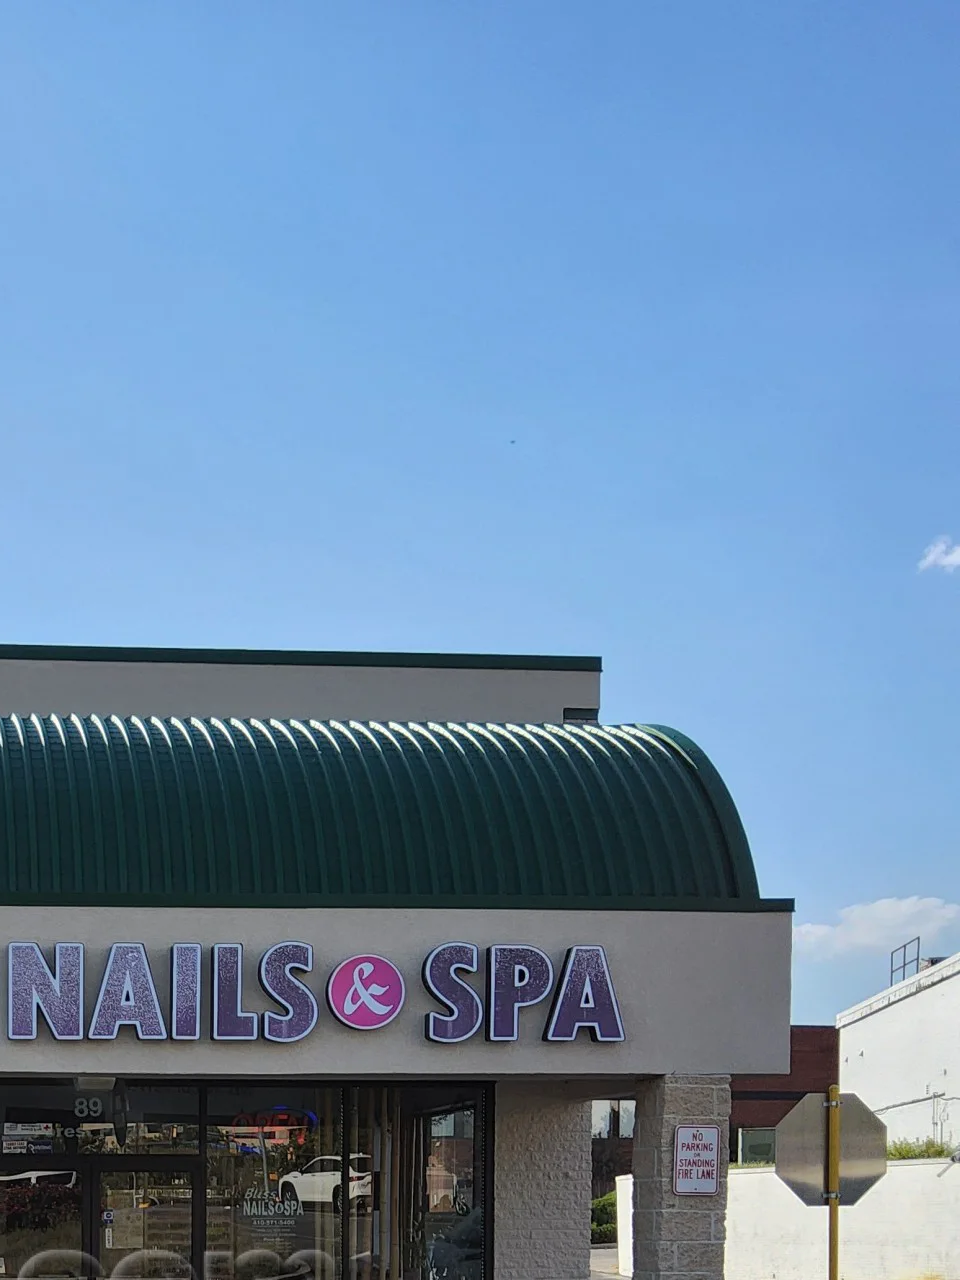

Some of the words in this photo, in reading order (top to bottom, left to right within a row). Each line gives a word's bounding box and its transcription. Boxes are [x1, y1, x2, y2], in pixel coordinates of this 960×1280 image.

[7, 940, 315, 1044] NAILS
[339, 963, 396, 1017] &
[424, 941, 626, 1045] SPA
[74, 1097, 103, 1118] 89
[692, 1133, 704, 1142] NO
[681, 1142, 714, 1152] PARKING
[679, 1158, 716, 1168] STANDING
[677, 1168, 693, 1180] FIRE
[696, 1168, 716, 1180] LANE
